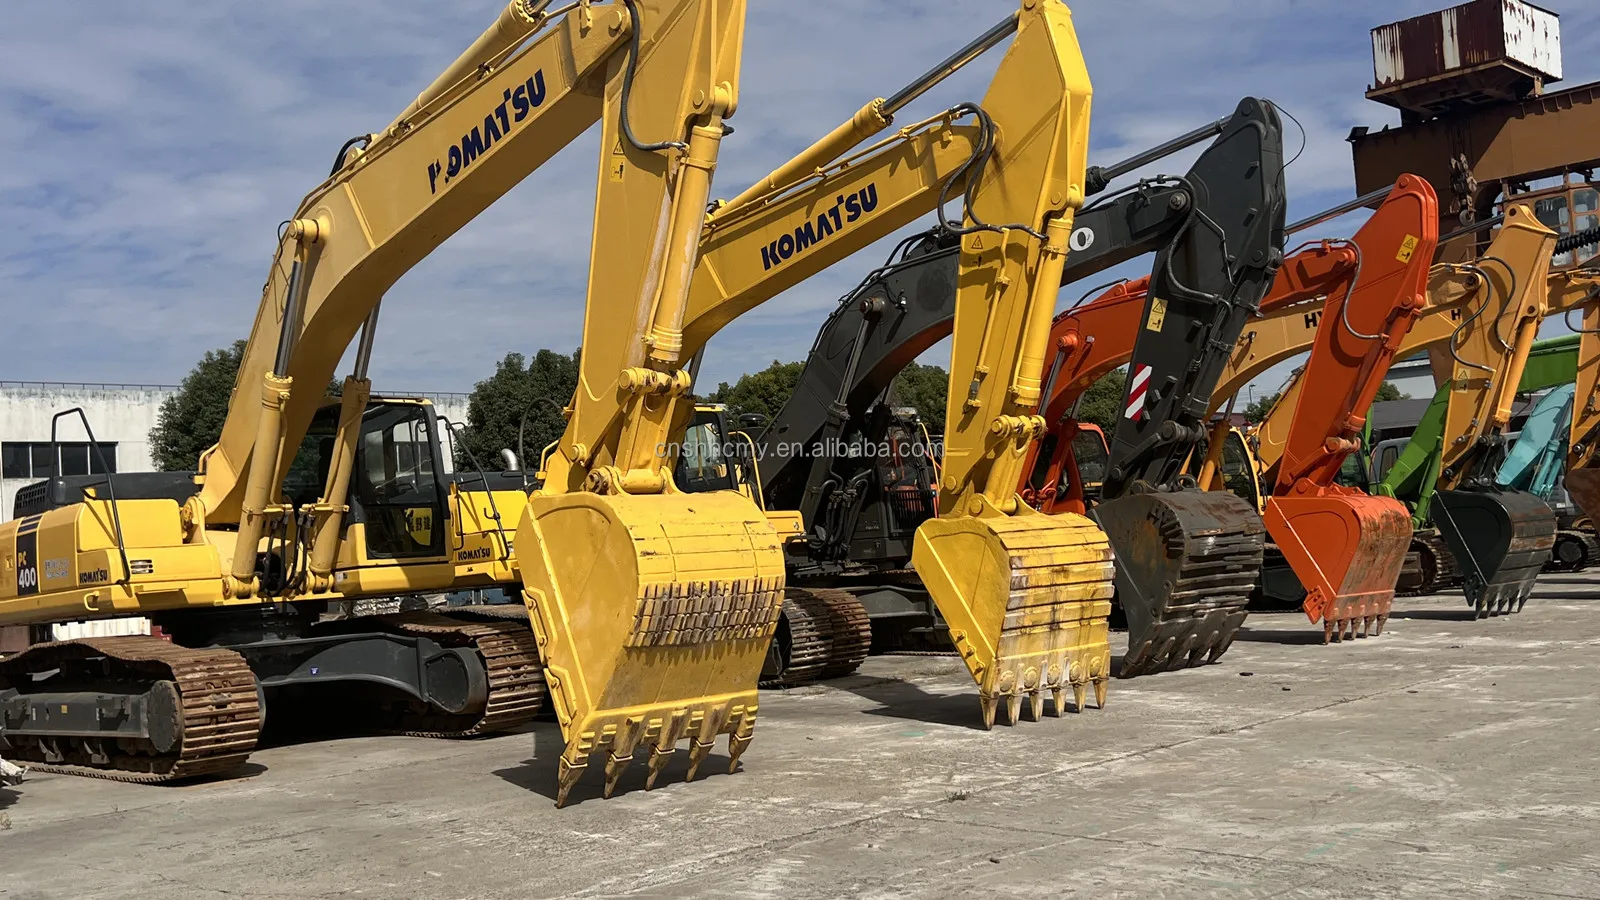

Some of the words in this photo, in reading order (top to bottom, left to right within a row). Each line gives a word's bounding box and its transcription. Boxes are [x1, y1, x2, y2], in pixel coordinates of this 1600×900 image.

[760, 182, 878, 271] KOMATSU
[18, 551, 27, 567] PC
[457, 547, 491, 561] KOMATSU
[18, 567, 36, 588] 400
[79, 568, 108, 584] KOMATSU
